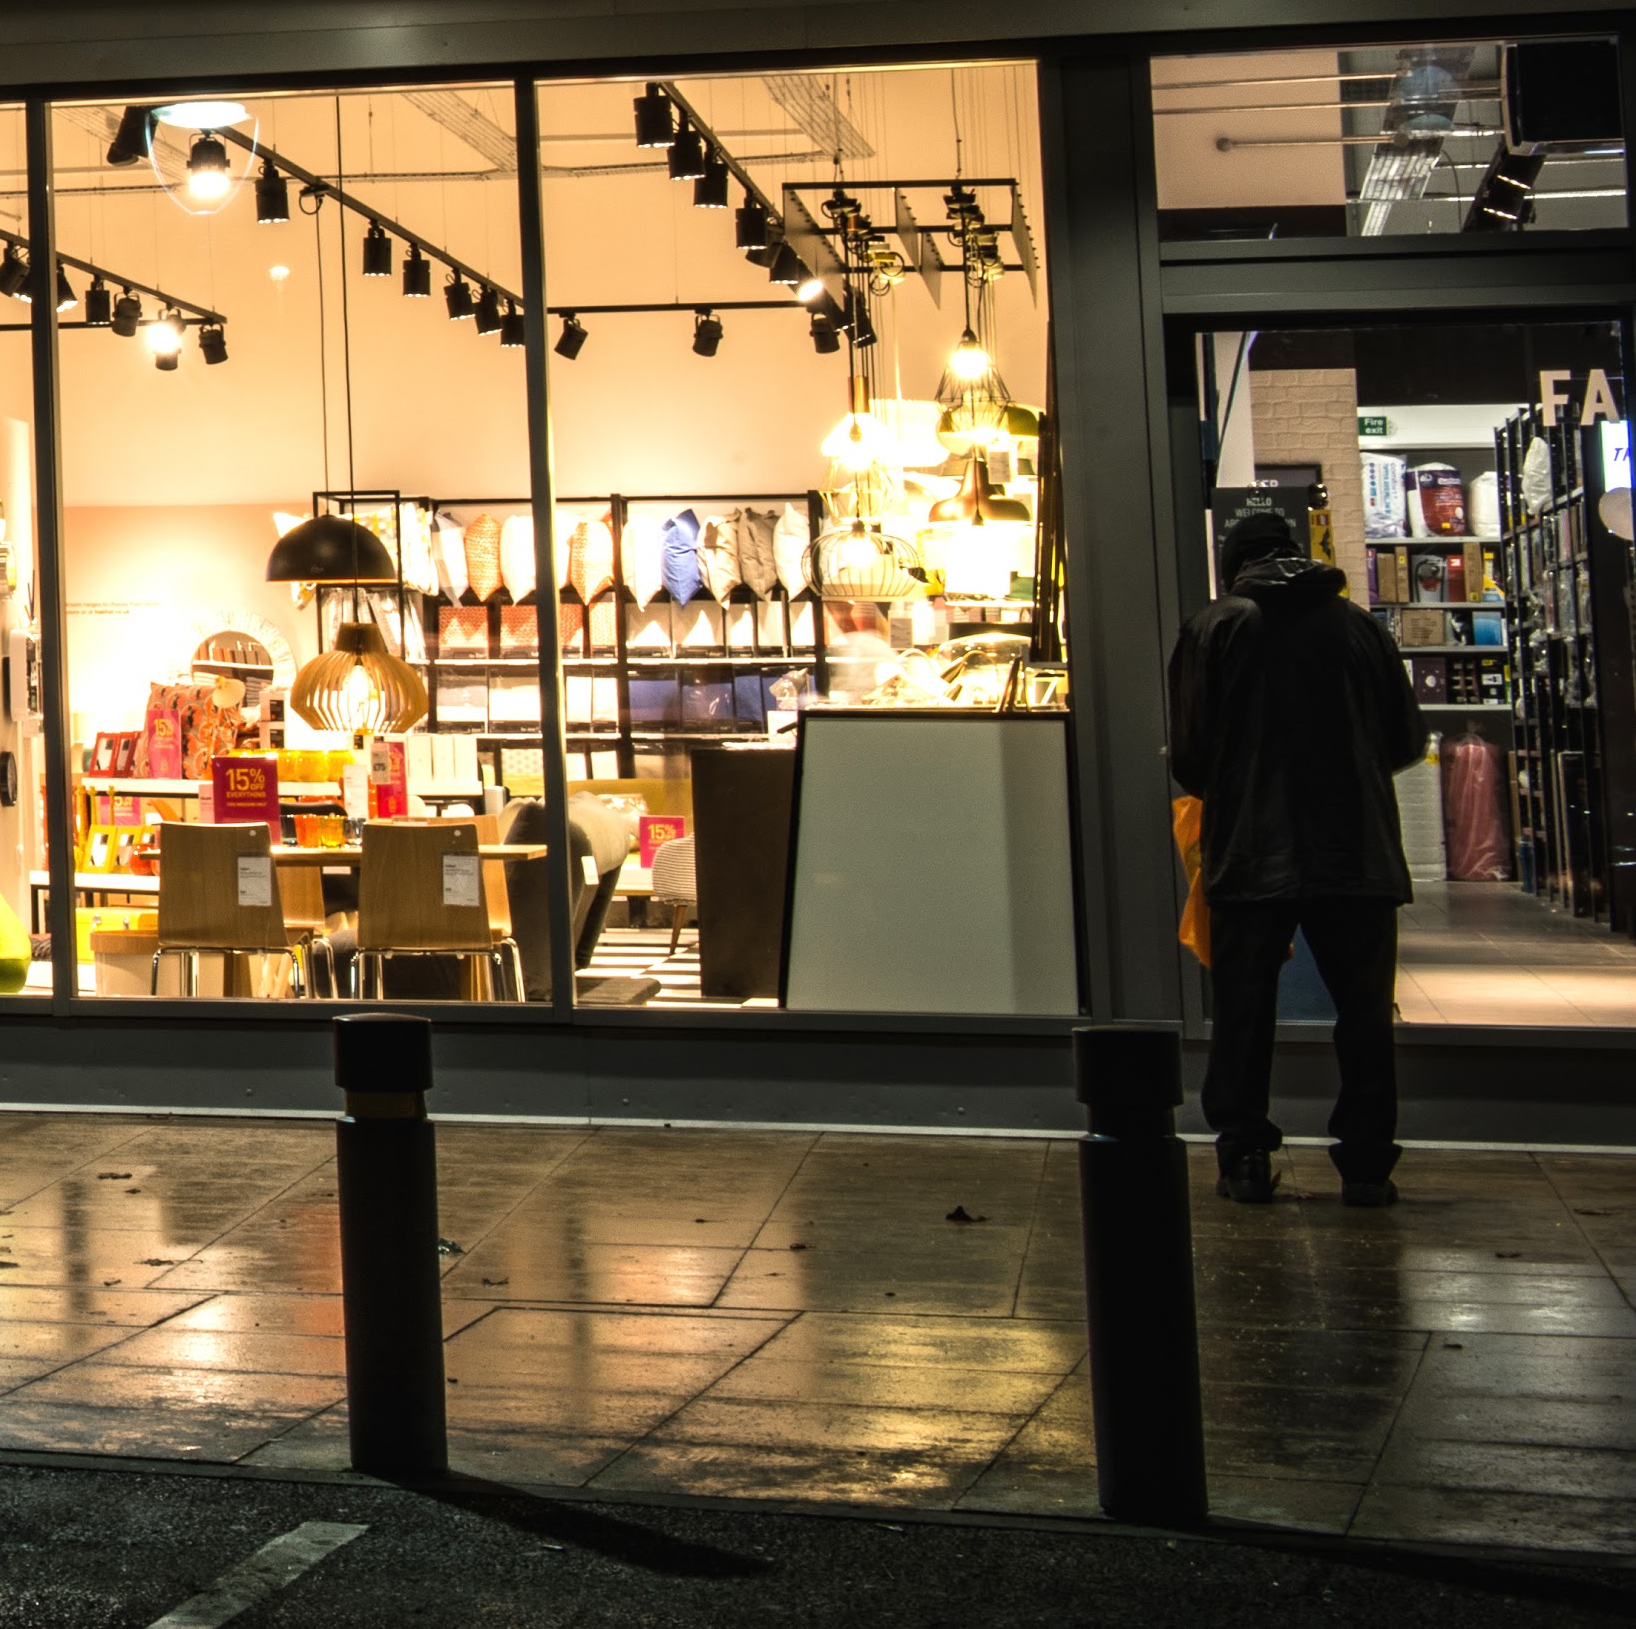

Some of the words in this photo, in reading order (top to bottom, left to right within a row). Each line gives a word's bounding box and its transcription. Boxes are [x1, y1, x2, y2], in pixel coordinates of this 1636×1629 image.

[1364, 418, 1384, 426] Fire
[226, 768, 266, 791] 15%
[250, 783, 265, 791] OFF
[226, 791, 267, 799] EVERYTHING
[648, 824, 676, 840] 15%
